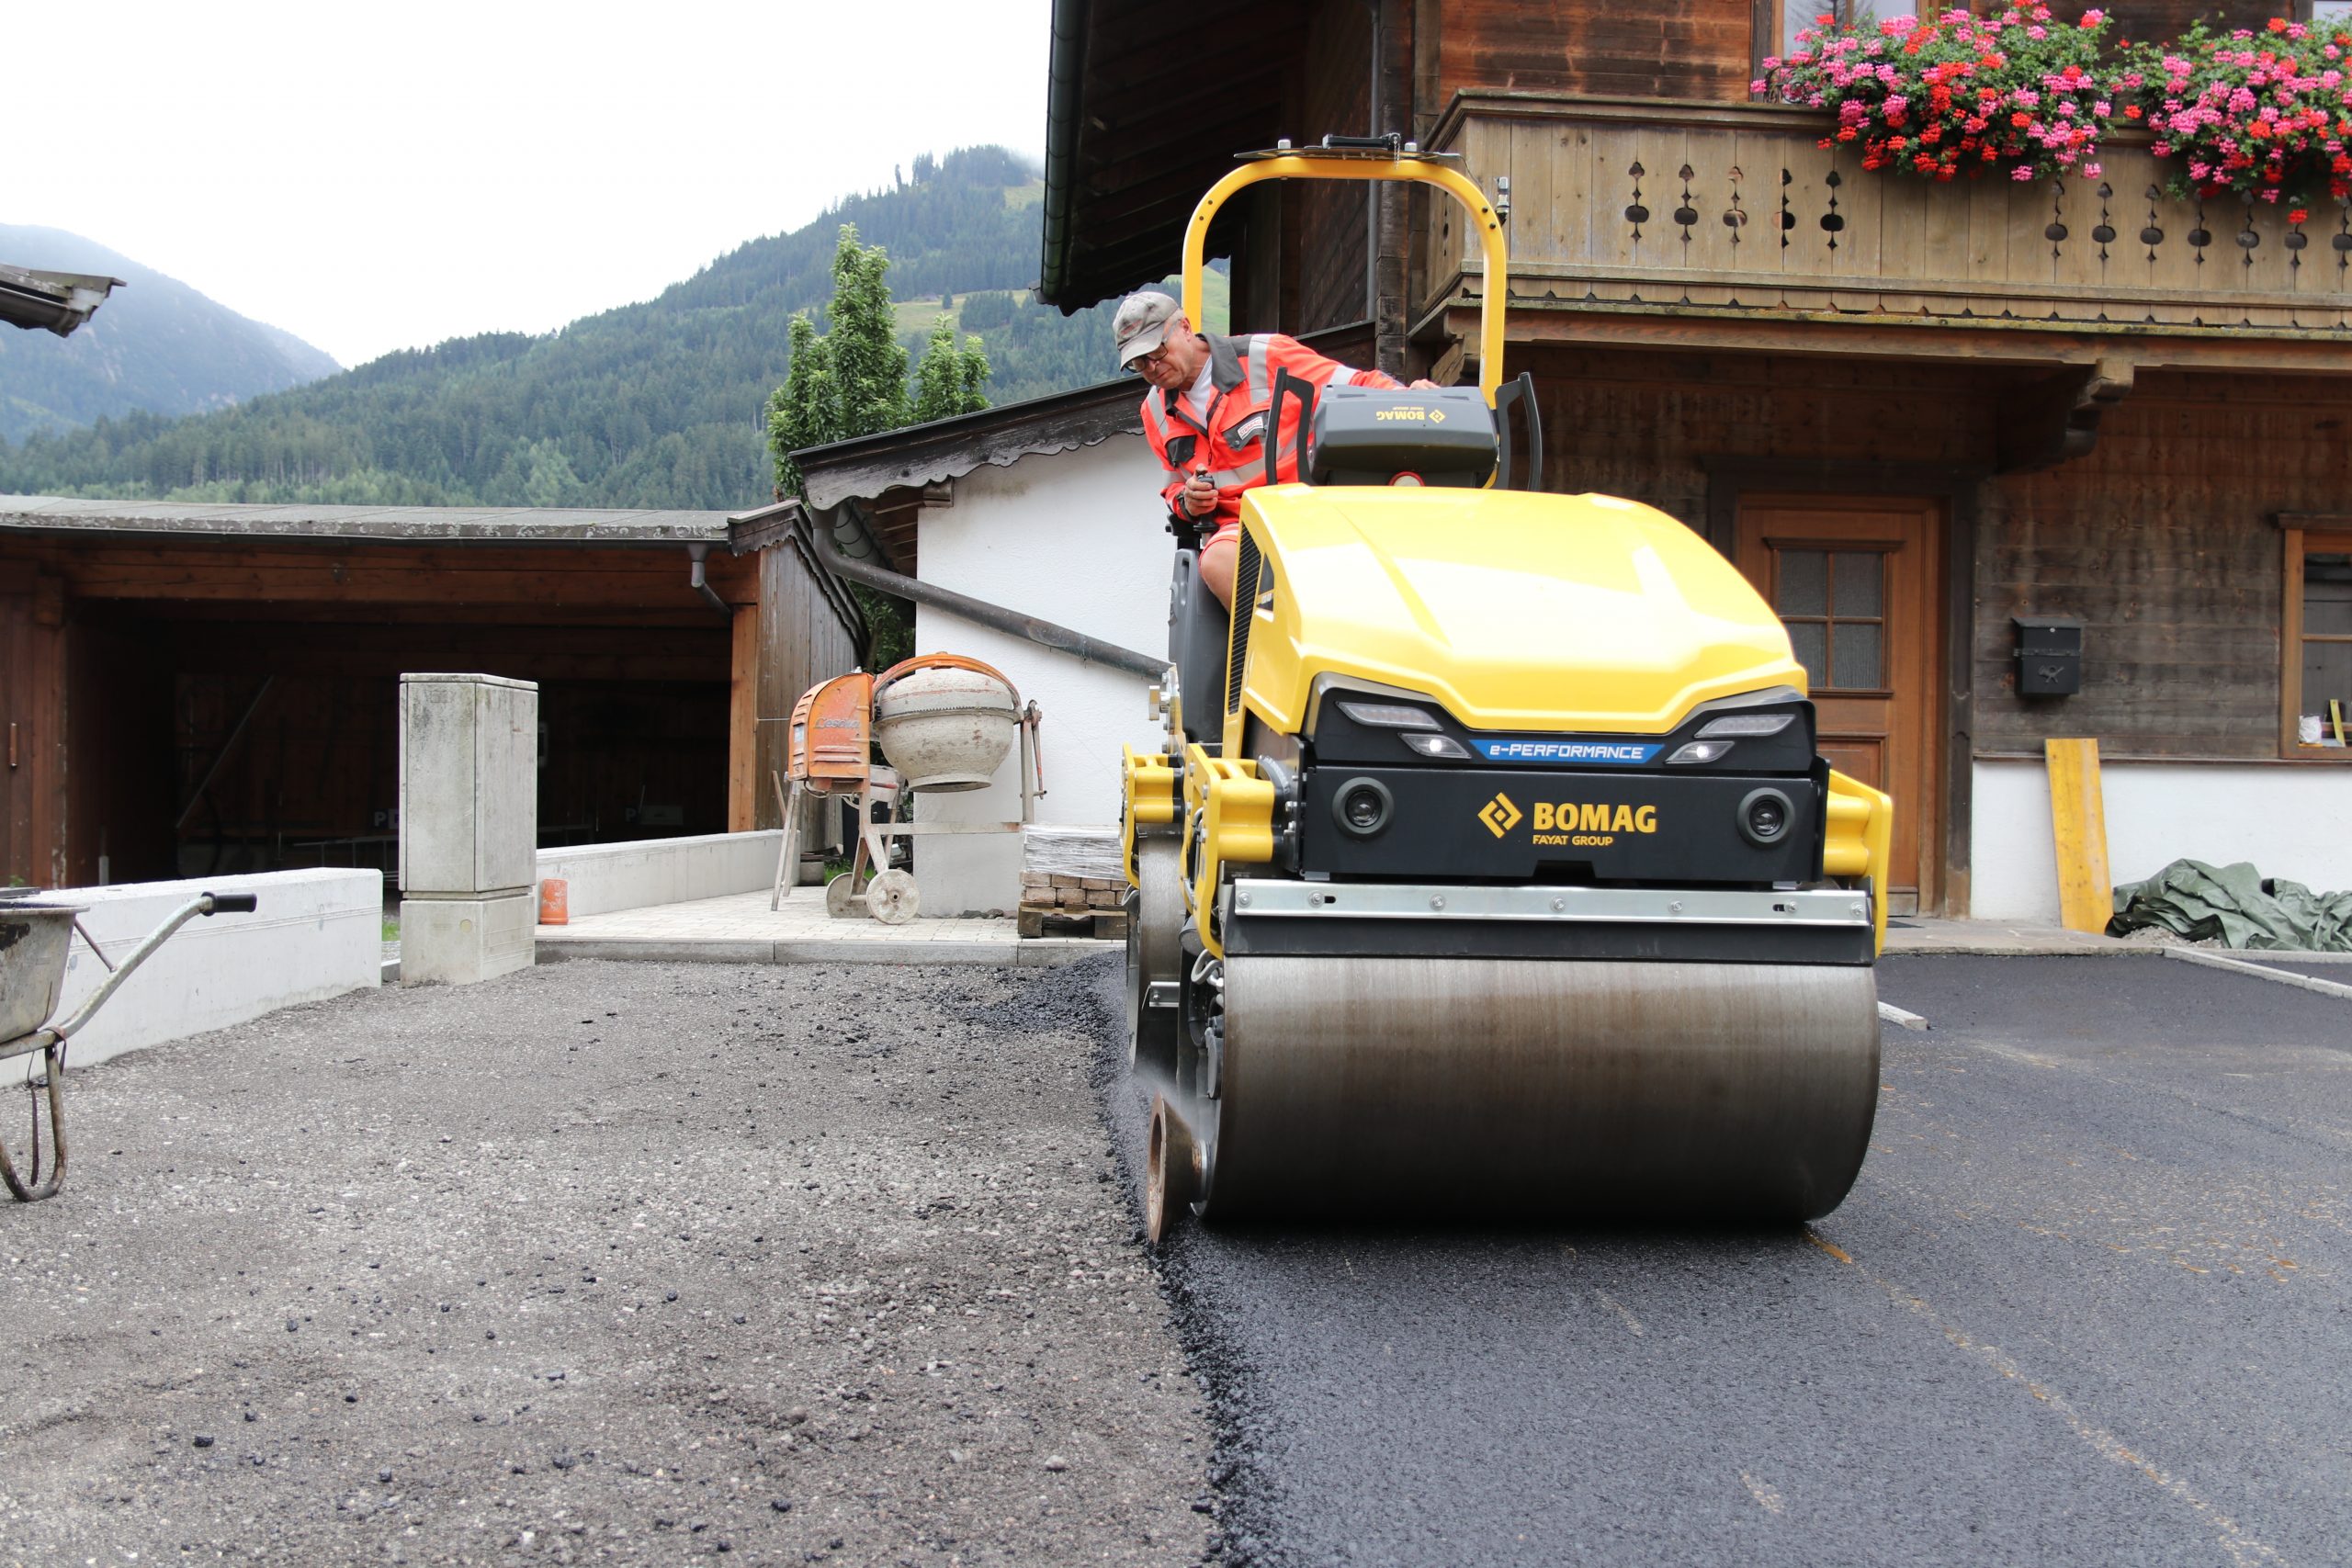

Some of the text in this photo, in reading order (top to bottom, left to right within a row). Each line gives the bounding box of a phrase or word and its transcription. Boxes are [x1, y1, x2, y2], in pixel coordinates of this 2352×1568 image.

[1376, 411, 1425, 421] BOMAG
[1489, 743, 1645, 761] e-PERFORMANCE
[1533, 802, 1657, 833] BOMAG
[1532, 834, 1613, 846] FAYAT GROUP
